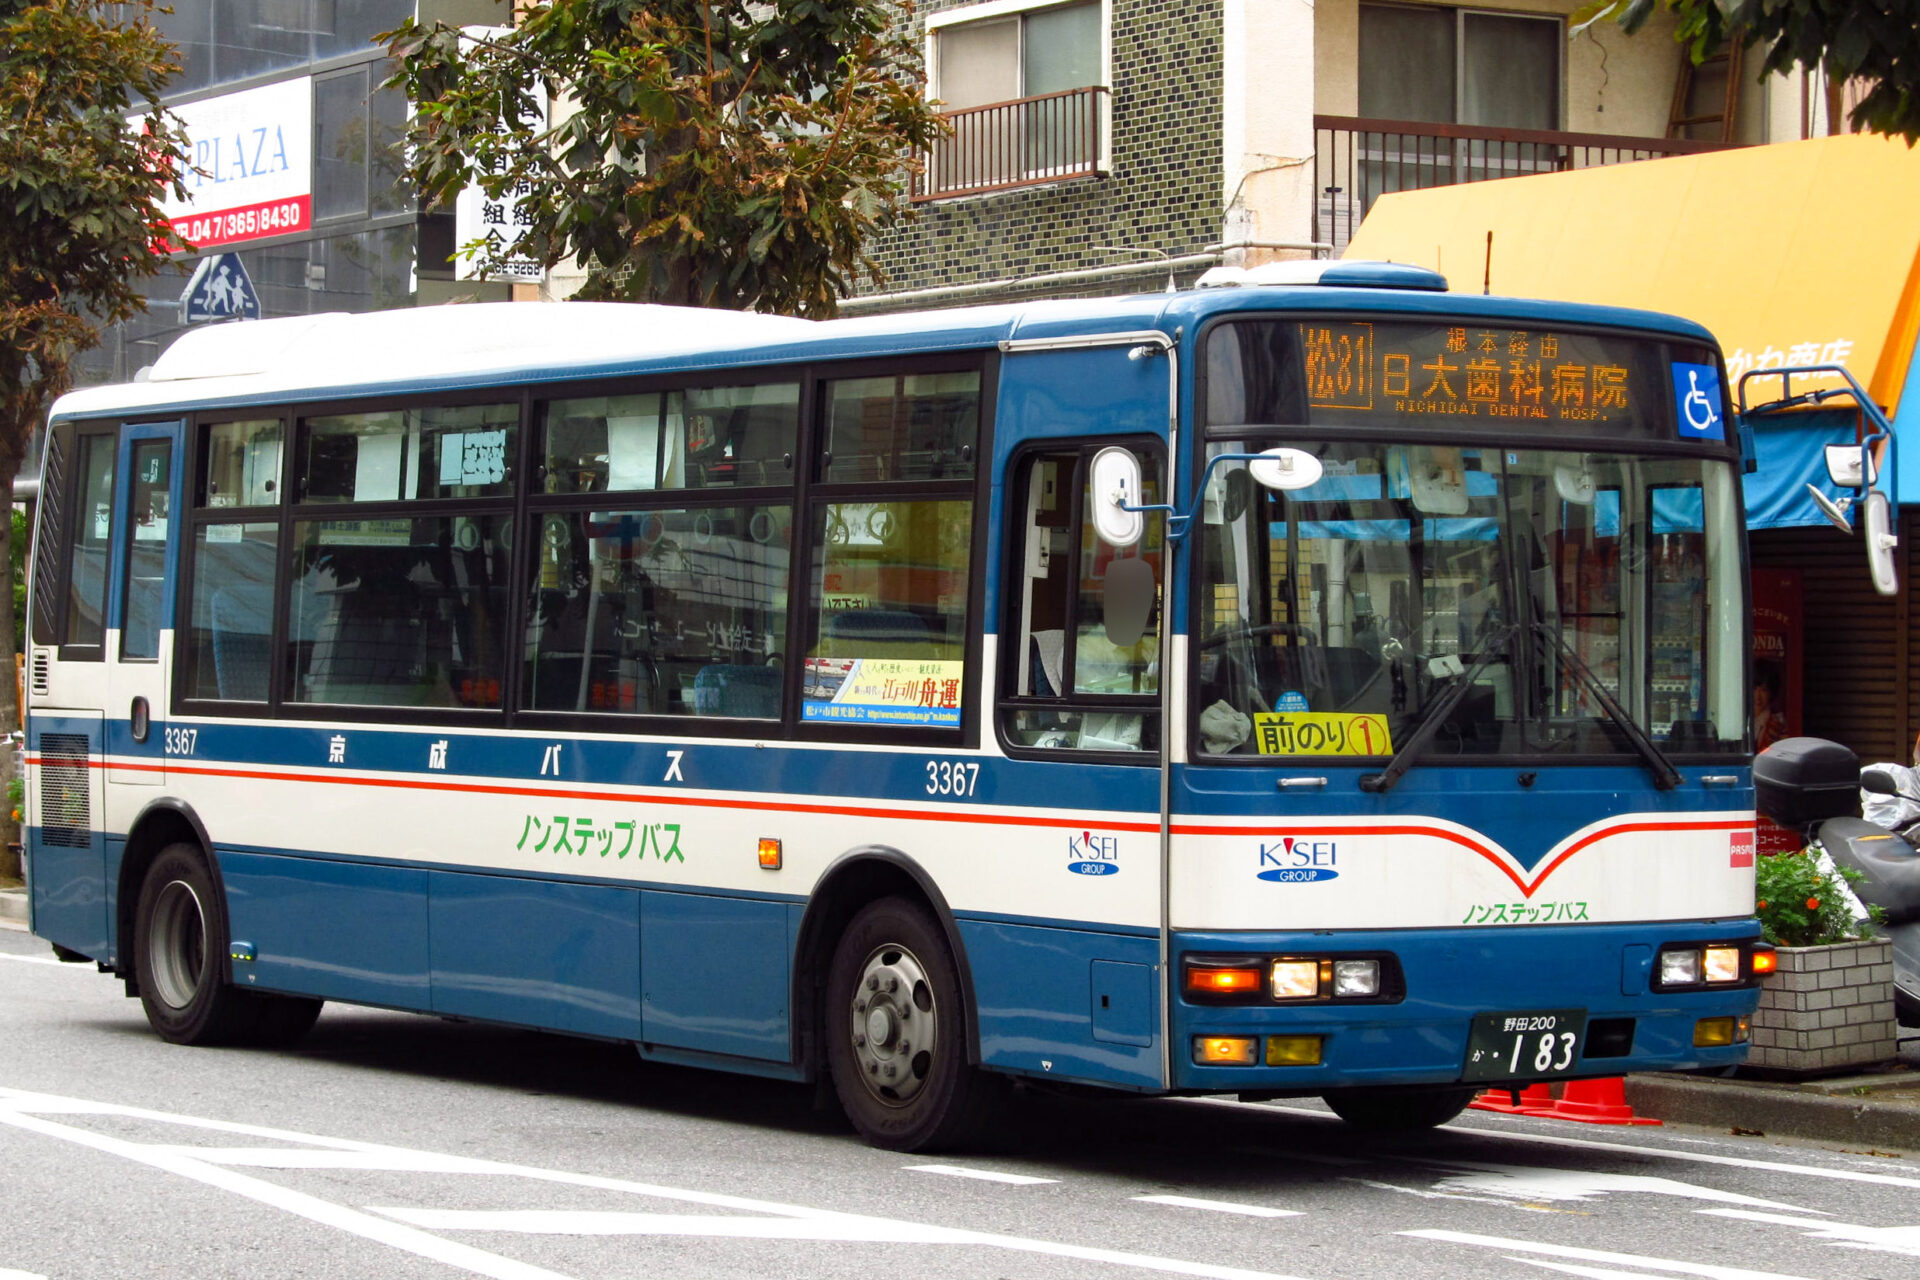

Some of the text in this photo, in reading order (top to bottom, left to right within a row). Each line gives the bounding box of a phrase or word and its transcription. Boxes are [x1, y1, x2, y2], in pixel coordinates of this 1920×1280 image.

[1447, 327, 1558, 359] 根本経由
[1383, 353, 1628, 409] 日大歯科病院
[1395, 399, 1478, 415] NICHIDAI
[1489, 403, 1548, 418] DENTAL
[165, 728, 197, 755] 3367
[1259, 716, 1345, 754] 前のり
[926, 761, 980, 796] 3367
[516, 814, 684, 863] ノンステップバス
[1081, 863, 1105, 875] GROUP
[1279, 870, 1317, 882] GROUP
[1462, 902, 1590, 924] ノンステップバス
